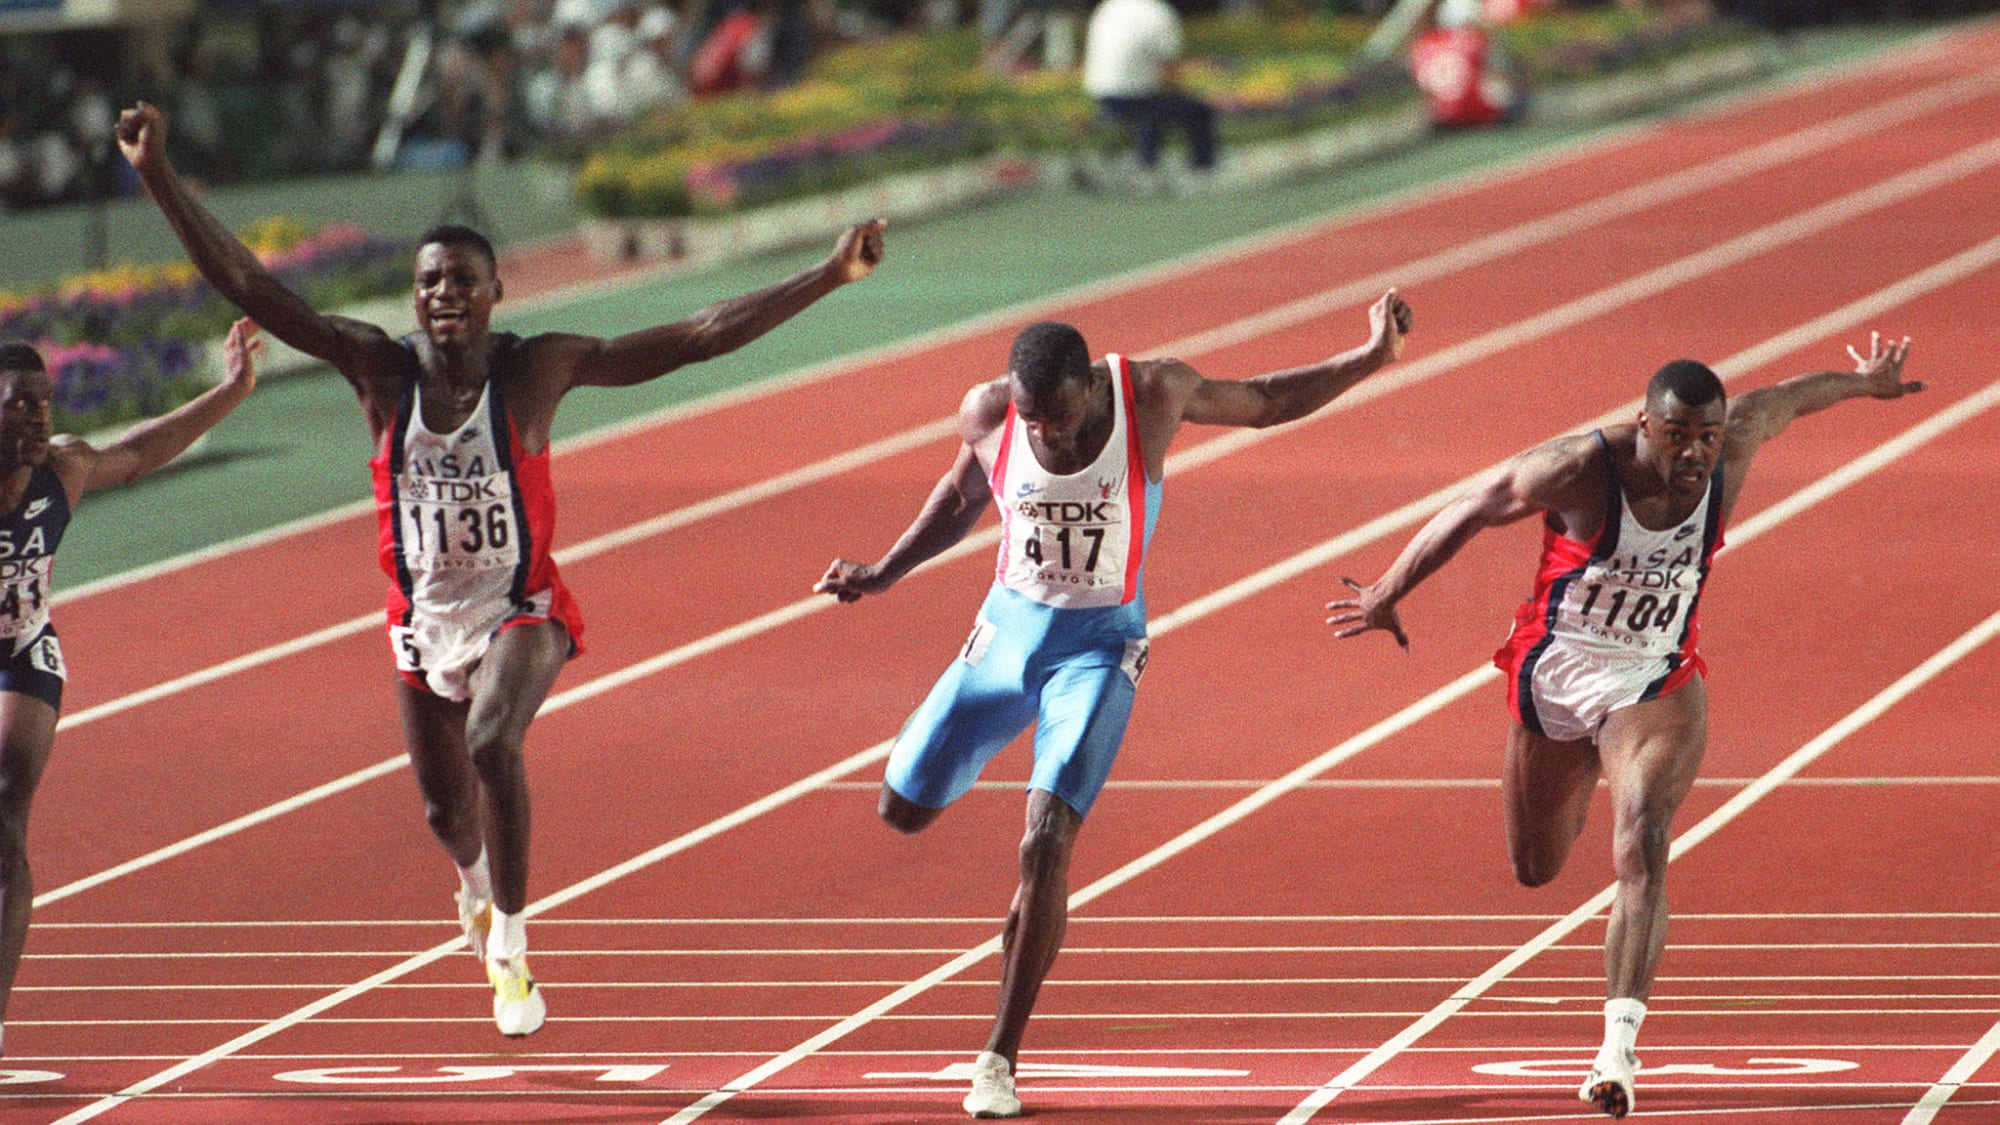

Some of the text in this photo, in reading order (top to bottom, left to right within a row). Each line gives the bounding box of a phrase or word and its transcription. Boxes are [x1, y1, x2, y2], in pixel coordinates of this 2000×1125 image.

[430, 479, 496, 501] TDK
[411, 503, 508, 554] 1136
[1038, 502, 1108, 522] TDK
[1025, 526, 1105, 573] 417
[1622, 571, 1684, 590] TDK
[1580, 584, 1682, 633] 1104
[41, 638, 59, 671] 6
[401, 633, 421, 667] 5
